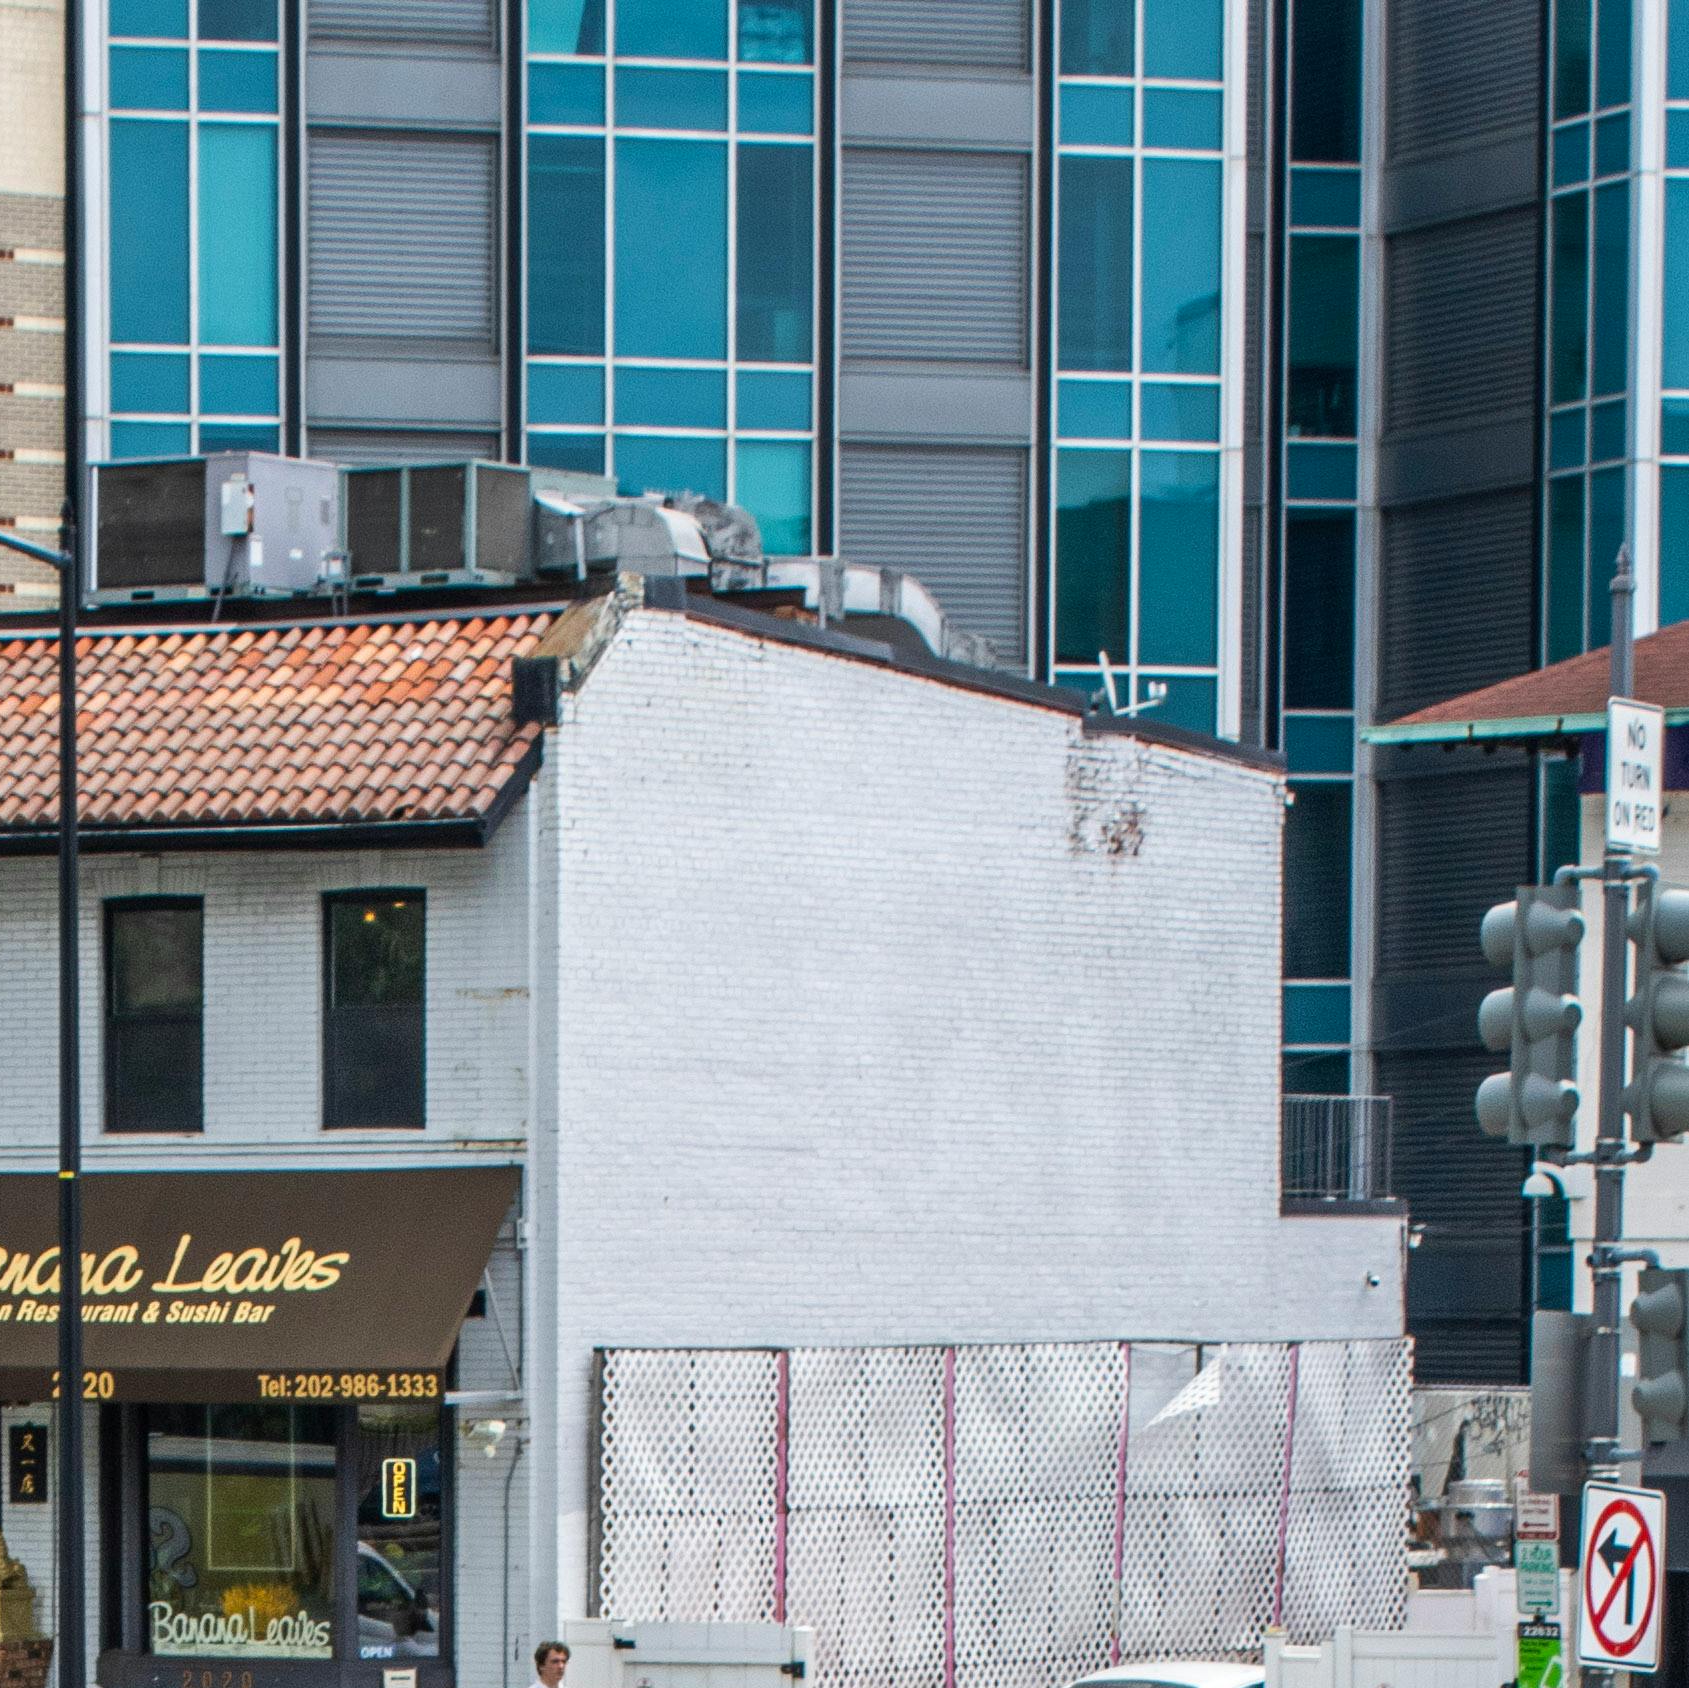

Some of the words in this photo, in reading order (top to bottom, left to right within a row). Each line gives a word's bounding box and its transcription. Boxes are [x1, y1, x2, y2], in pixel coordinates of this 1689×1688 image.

[1628, 718, 1646, 750] NO
[1621, 760, 1652, 791] TURN
[1615, 800, 1631, 827] ON
[1635, 803, 1656, 832] RED
[152, 1234, 350, 1295] Leaves
[16, 1300, 138, 1323] Resurant
[141, 1301, 158, 1323] &
[165, 1300, 228, 1323] Sushi
[233, 1301, 276, 1323] Bar
[52, 1371, 115, 1398] 220
[295, 1374, 438, 1398] 202-986-1333
[393, 1461, 407, 1514] OPEN
[148, 1601, 248, 1645] Banana
[248, 1605, 332, 1646] Leaves
[361, 1646, 394, 1659] OPEN
